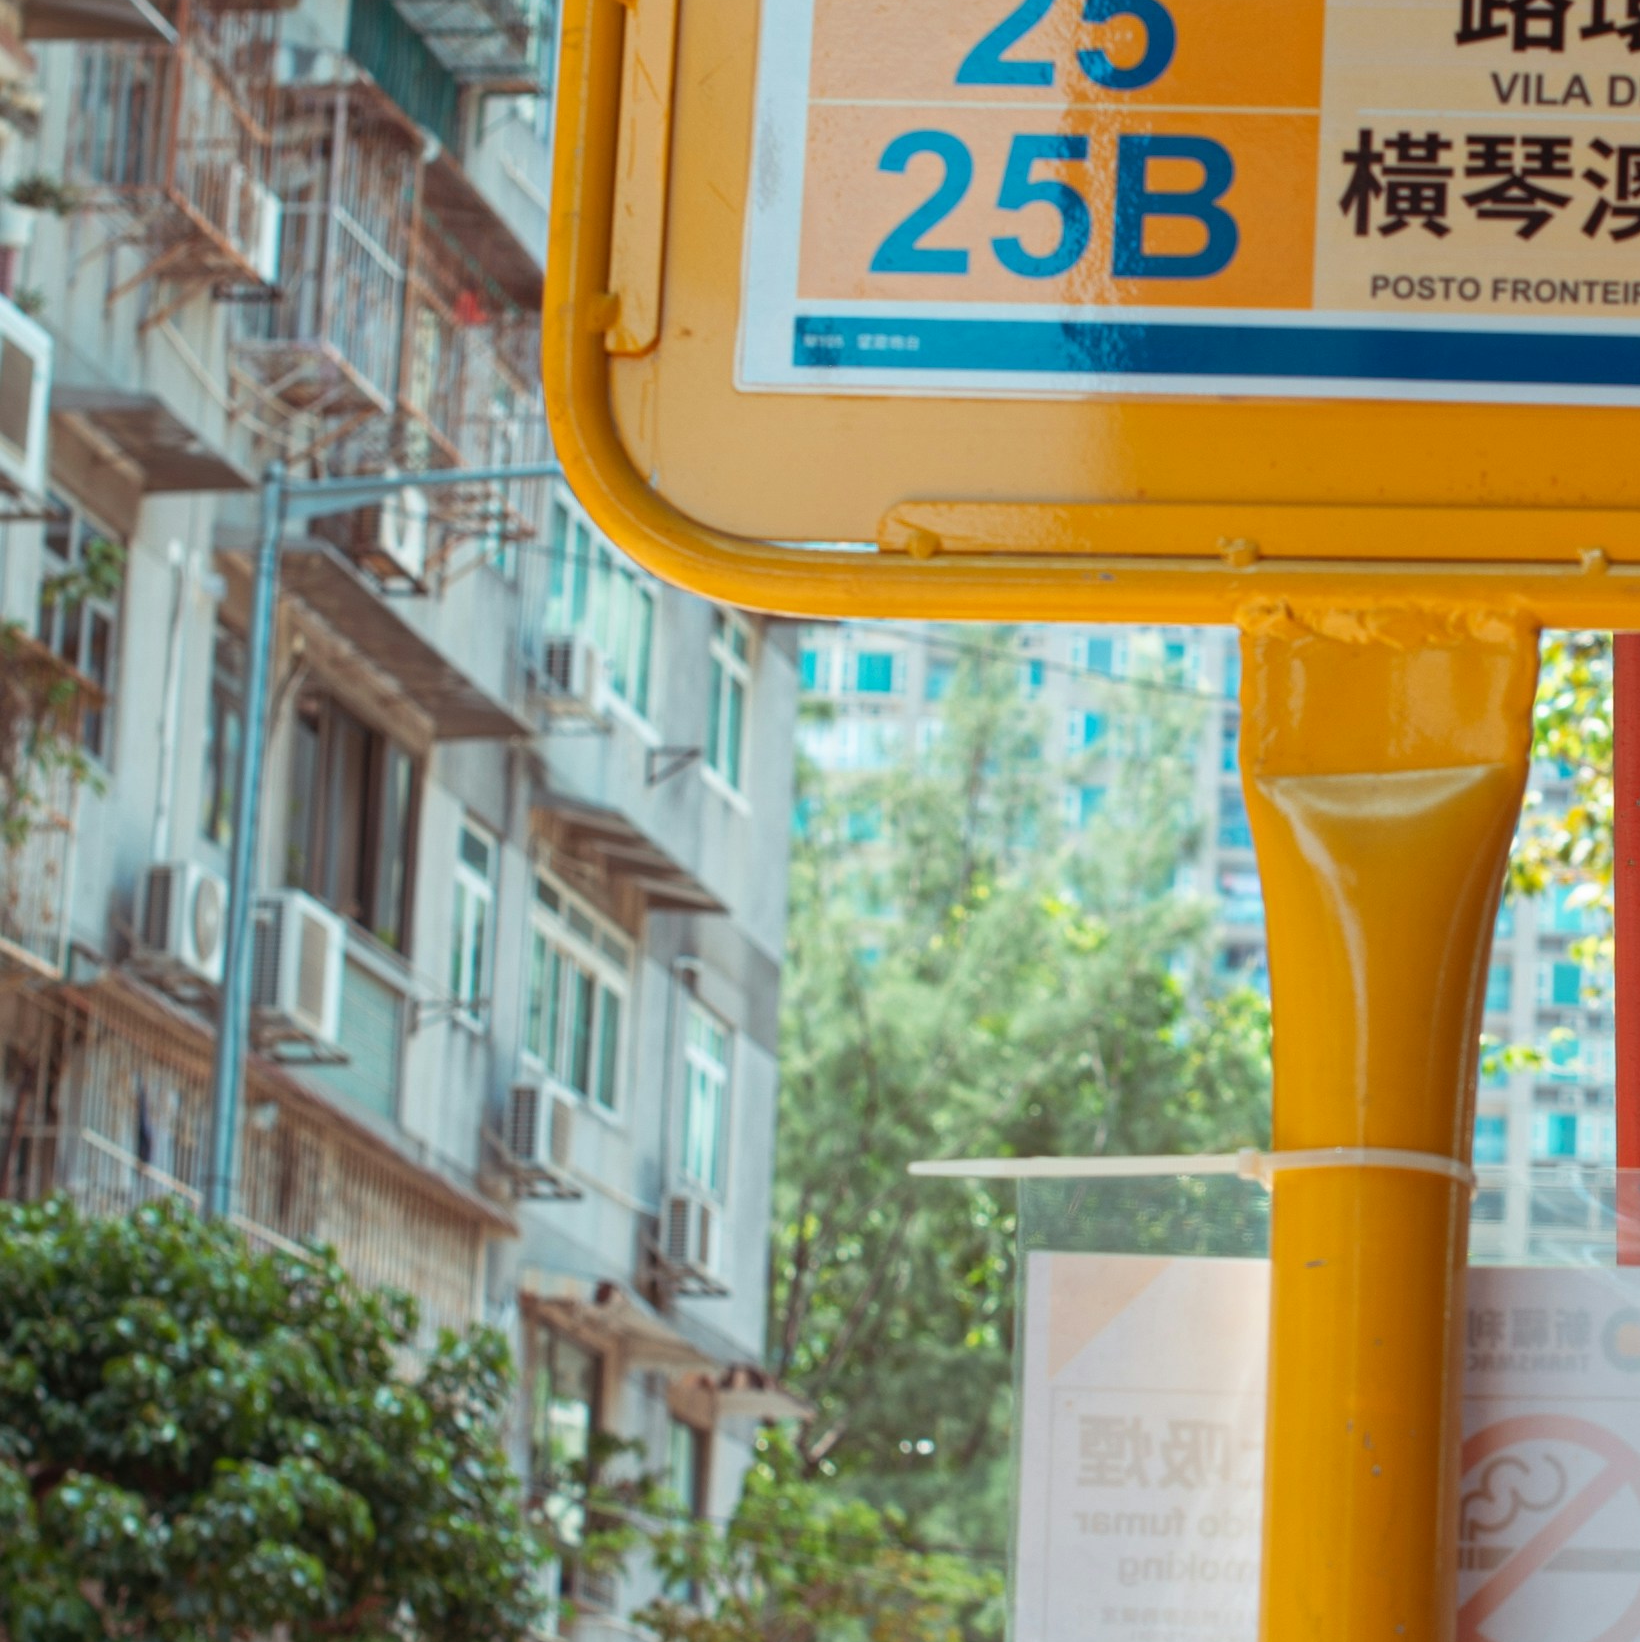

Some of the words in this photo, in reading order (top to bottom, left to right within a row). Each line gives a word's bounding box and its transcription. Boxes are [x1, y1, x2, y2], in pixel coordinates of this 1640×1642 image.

[1491, 72, 1591, 106] VILA
[868, 128, 1240, 280] 25B
[1371, 275, 1481, 301] POSTO
